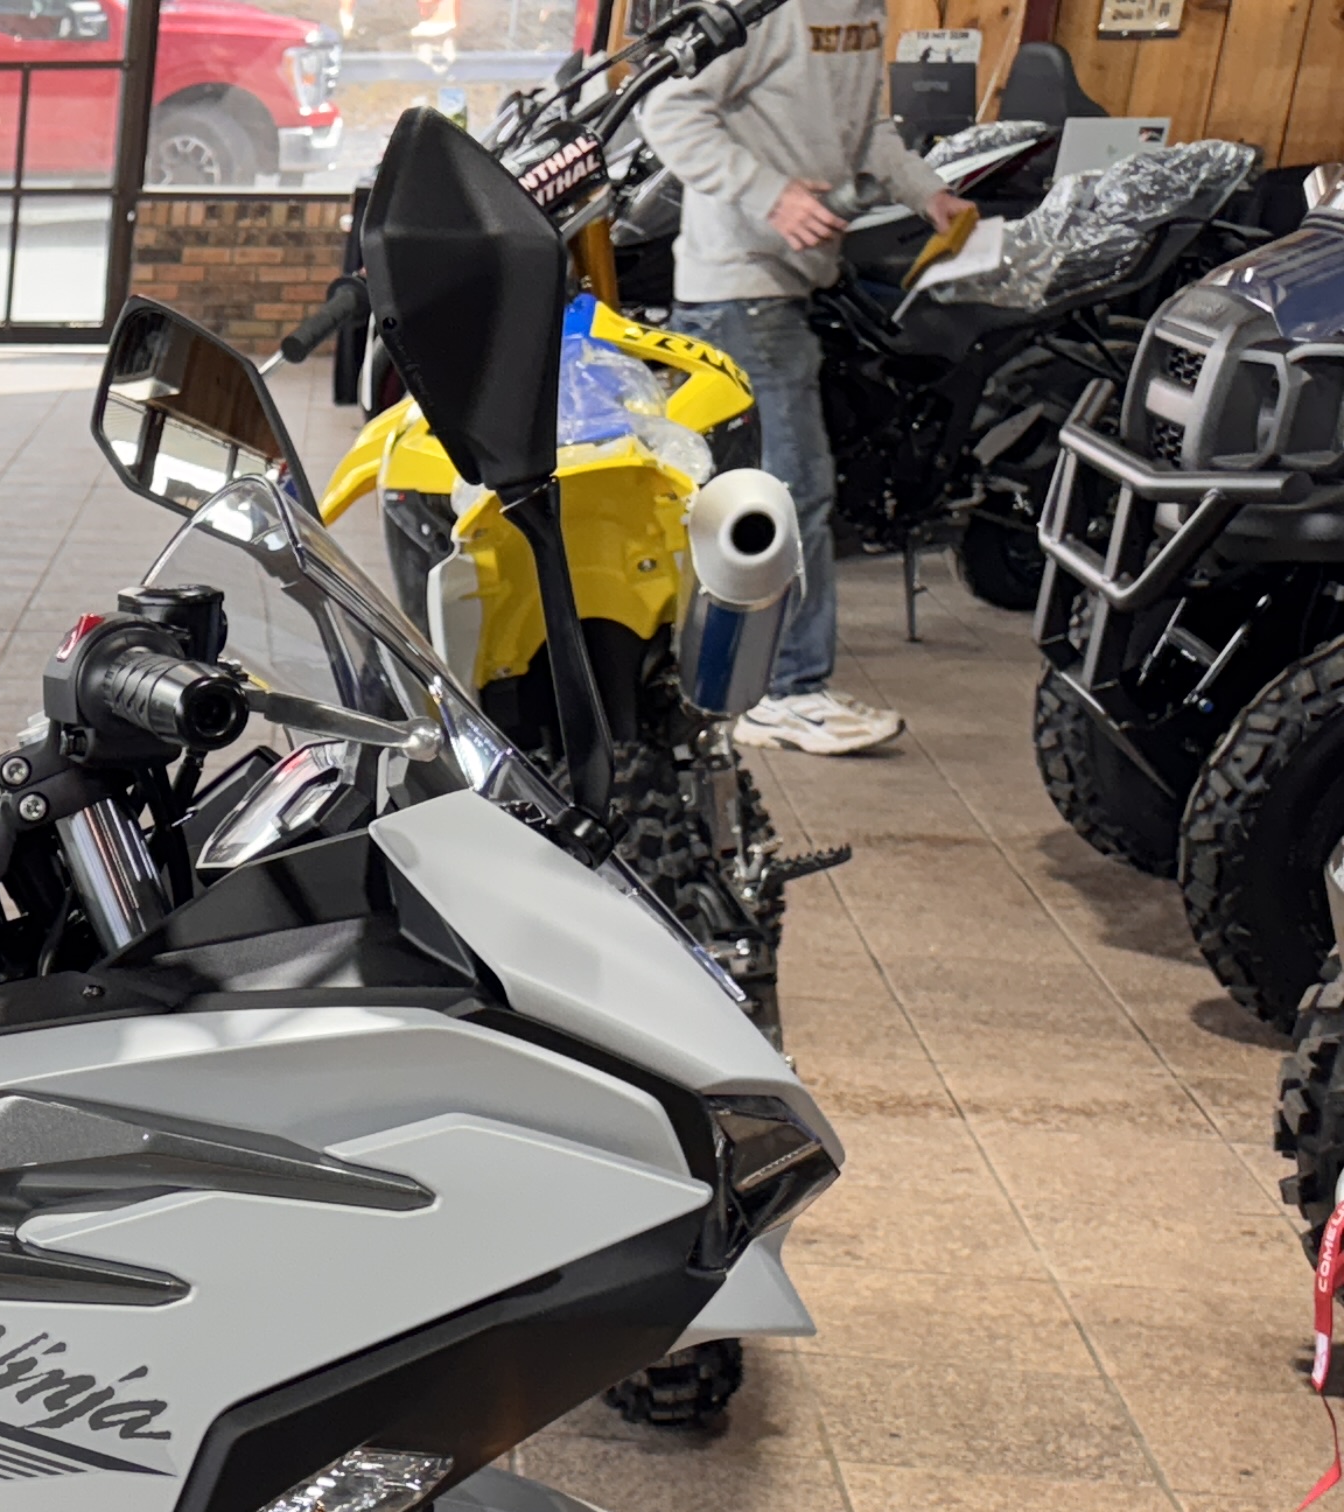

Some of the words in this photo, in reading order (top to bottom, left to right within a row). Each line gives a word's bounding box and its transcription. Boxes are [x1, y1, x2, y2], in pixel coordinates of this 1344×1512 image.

[518, 136, 598, 192] NTHAL
[532, 153, 601, 206] NTHAL
[1318, 1203, 1344, 1293] COMEU
